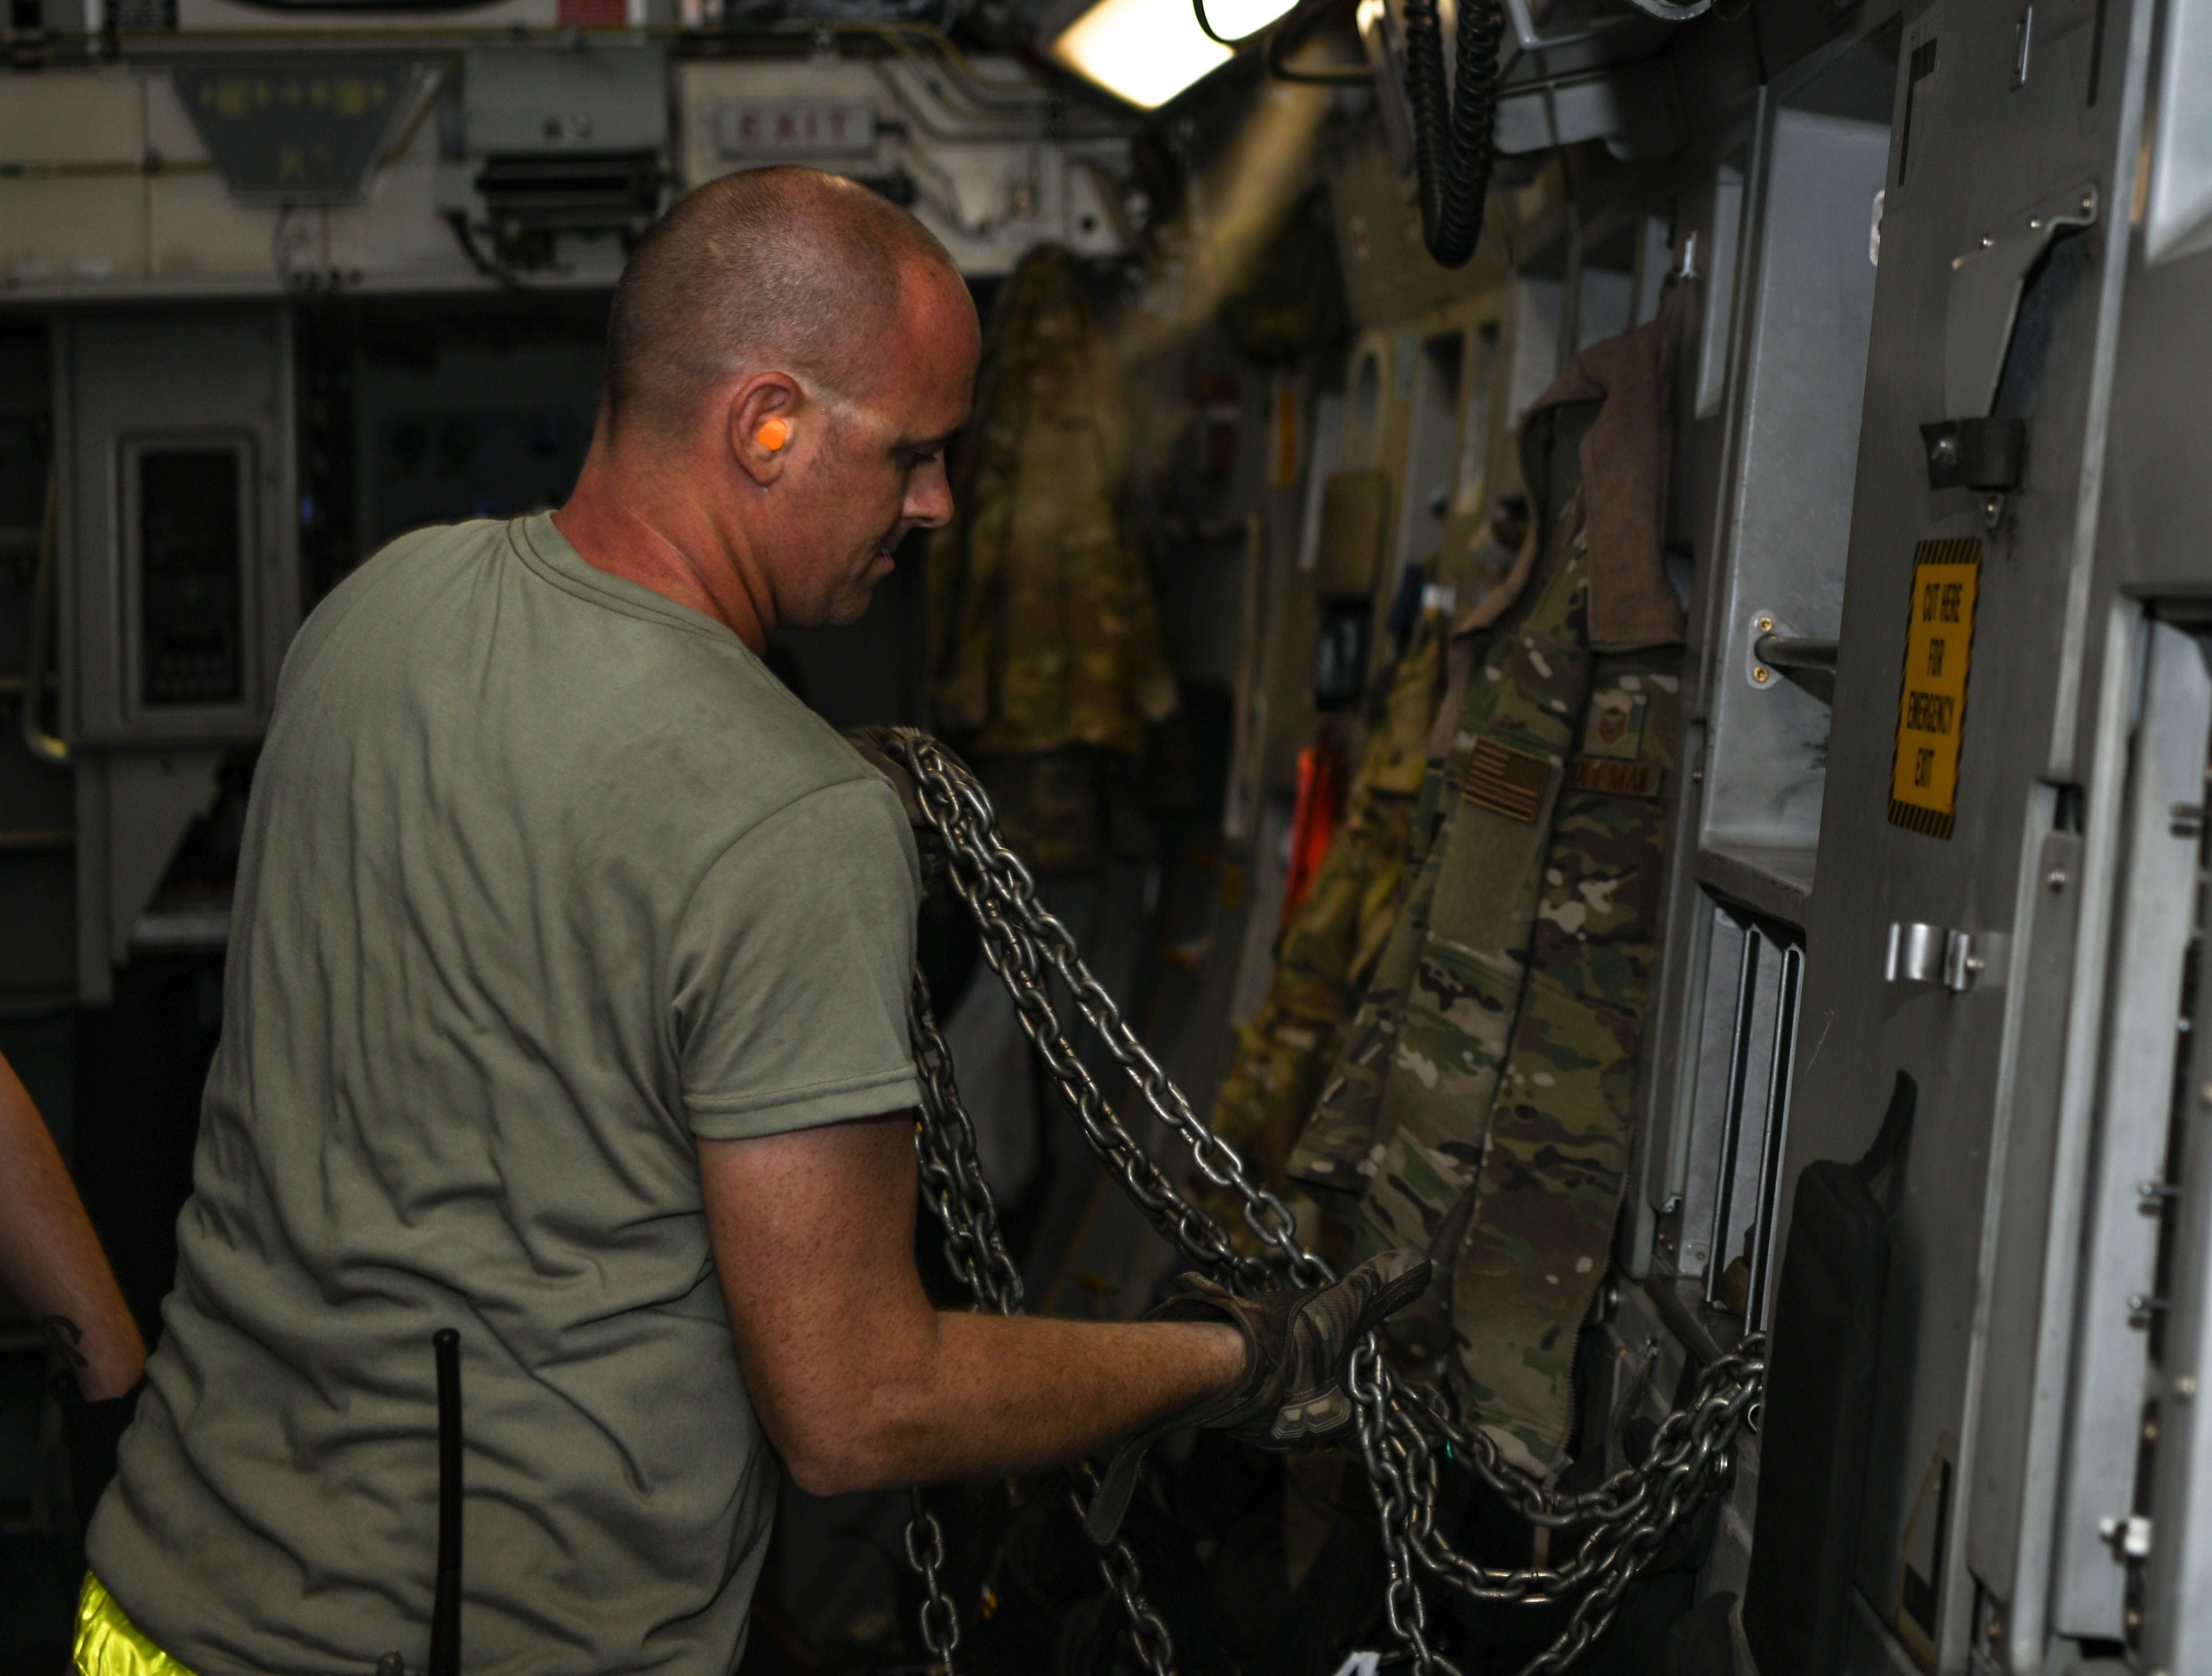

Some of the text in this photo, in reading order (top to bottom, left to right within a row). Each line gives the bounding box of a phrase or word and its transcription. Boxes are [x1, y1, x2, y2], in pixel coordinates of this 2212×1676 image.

[738, 107, 849, 145] EXIT
[1923, 582, 1963, 622] CUT HERE
[1927, 637, 1944, 677] FOR
[1907, 691, 1955, 735] EMERGENCY
[1915, 747, 1933, 789] EXIT
